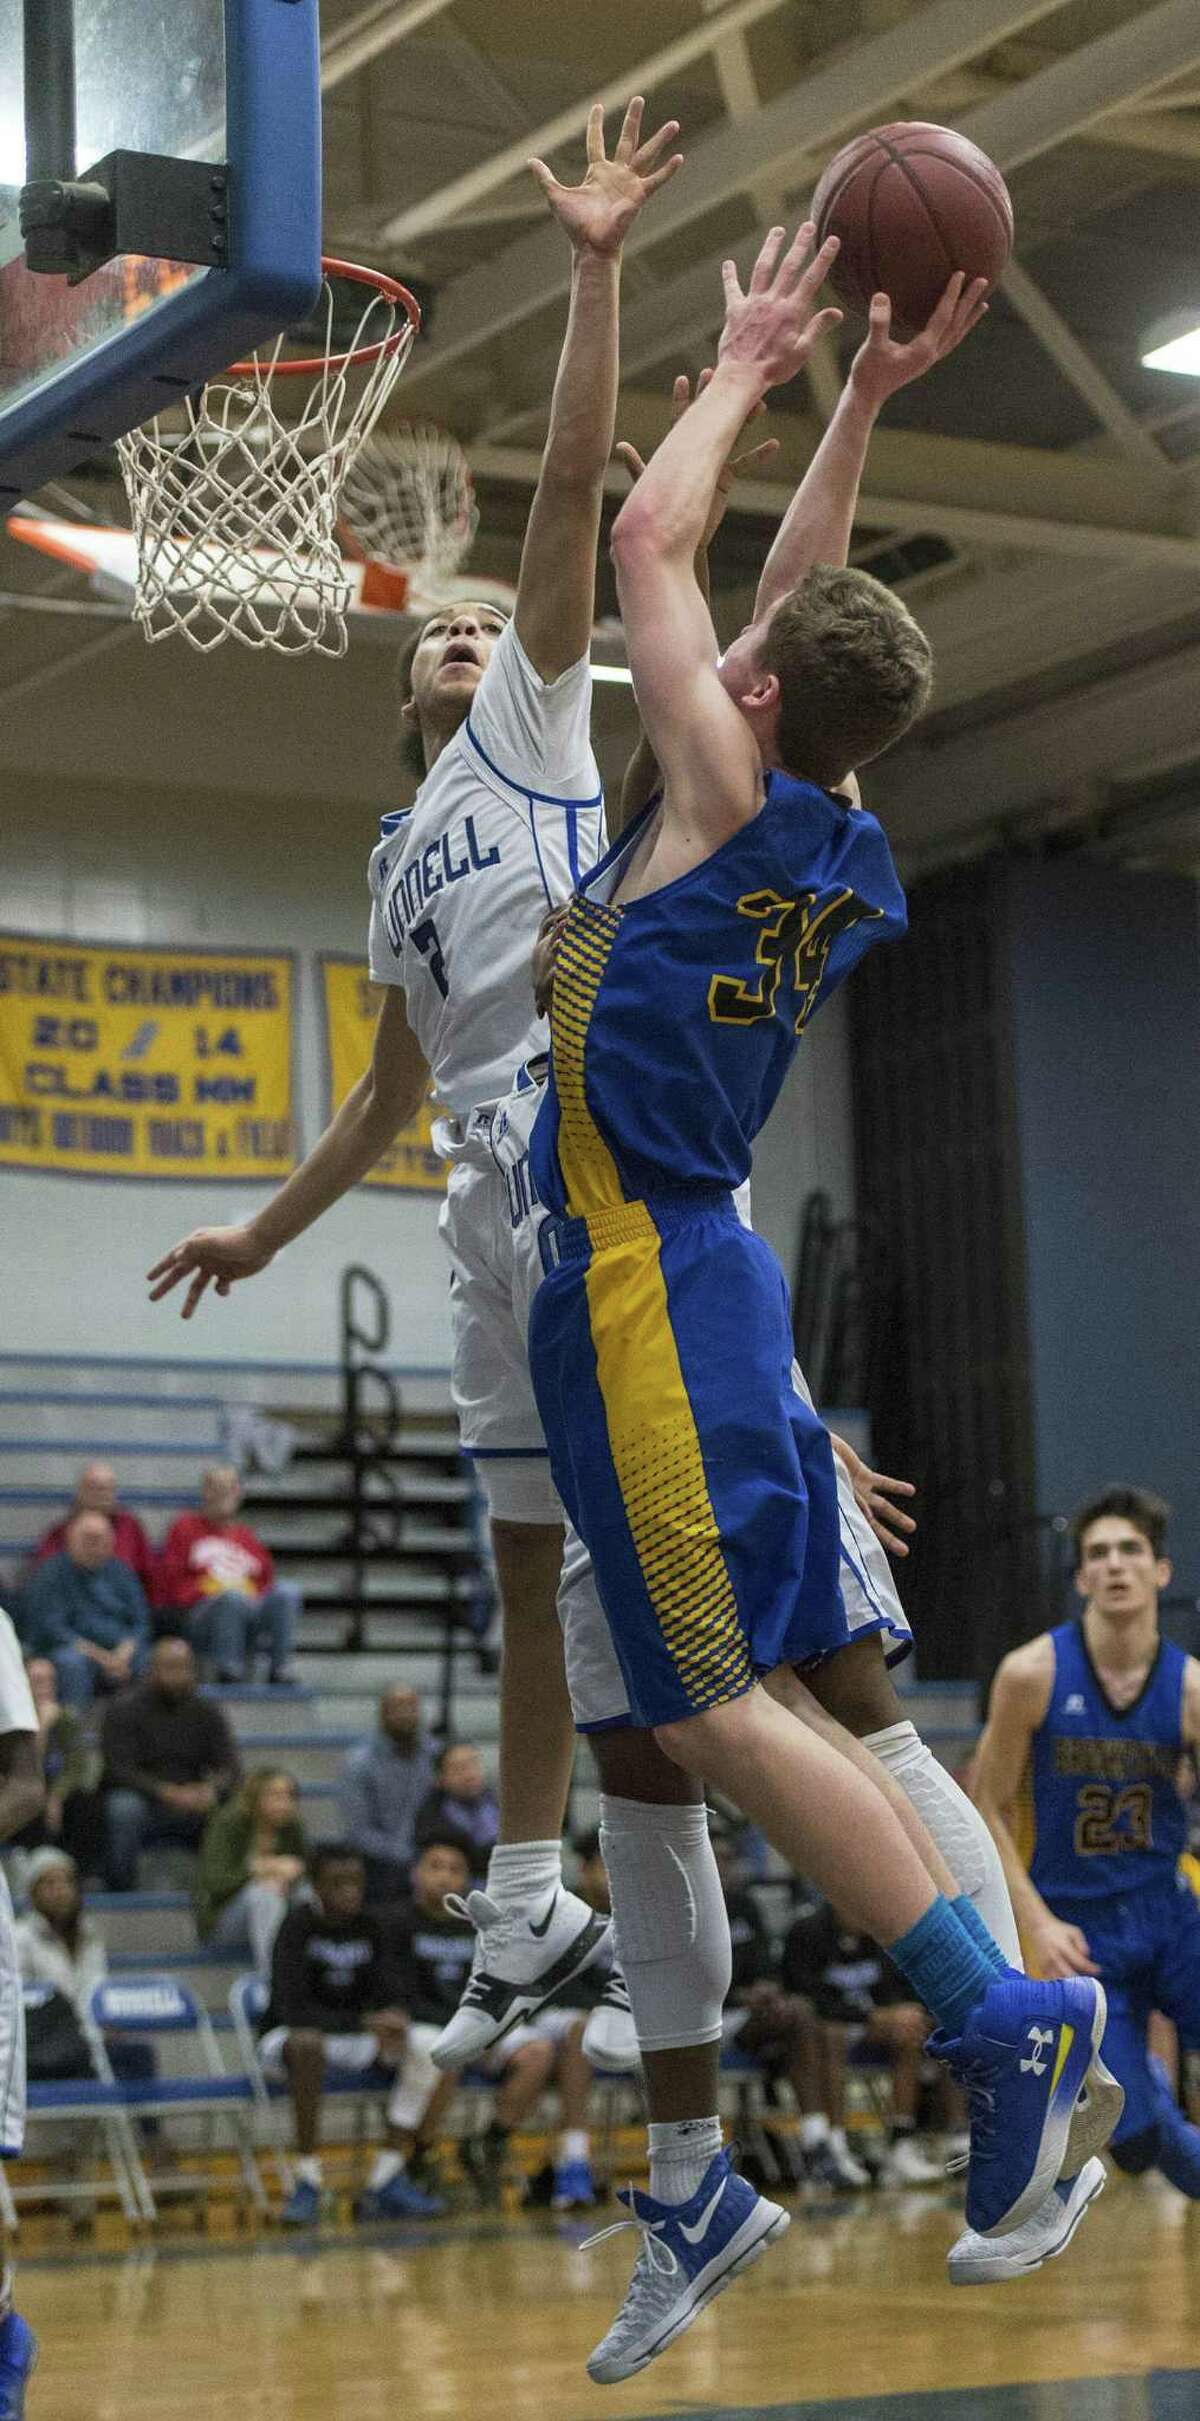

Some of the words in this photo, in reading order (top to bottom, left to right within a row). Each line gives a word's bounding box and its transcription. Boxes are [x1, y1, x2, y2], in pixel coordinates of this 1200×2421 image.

[707, 887, 885, 1036] 34
[104, 963, 279, 1009] CHAMPIONS
[33, 1014, 98, 1050] 20
[194, 1024, 243, 1058] 14
[24, 1061, 180, 1102] CLASS
